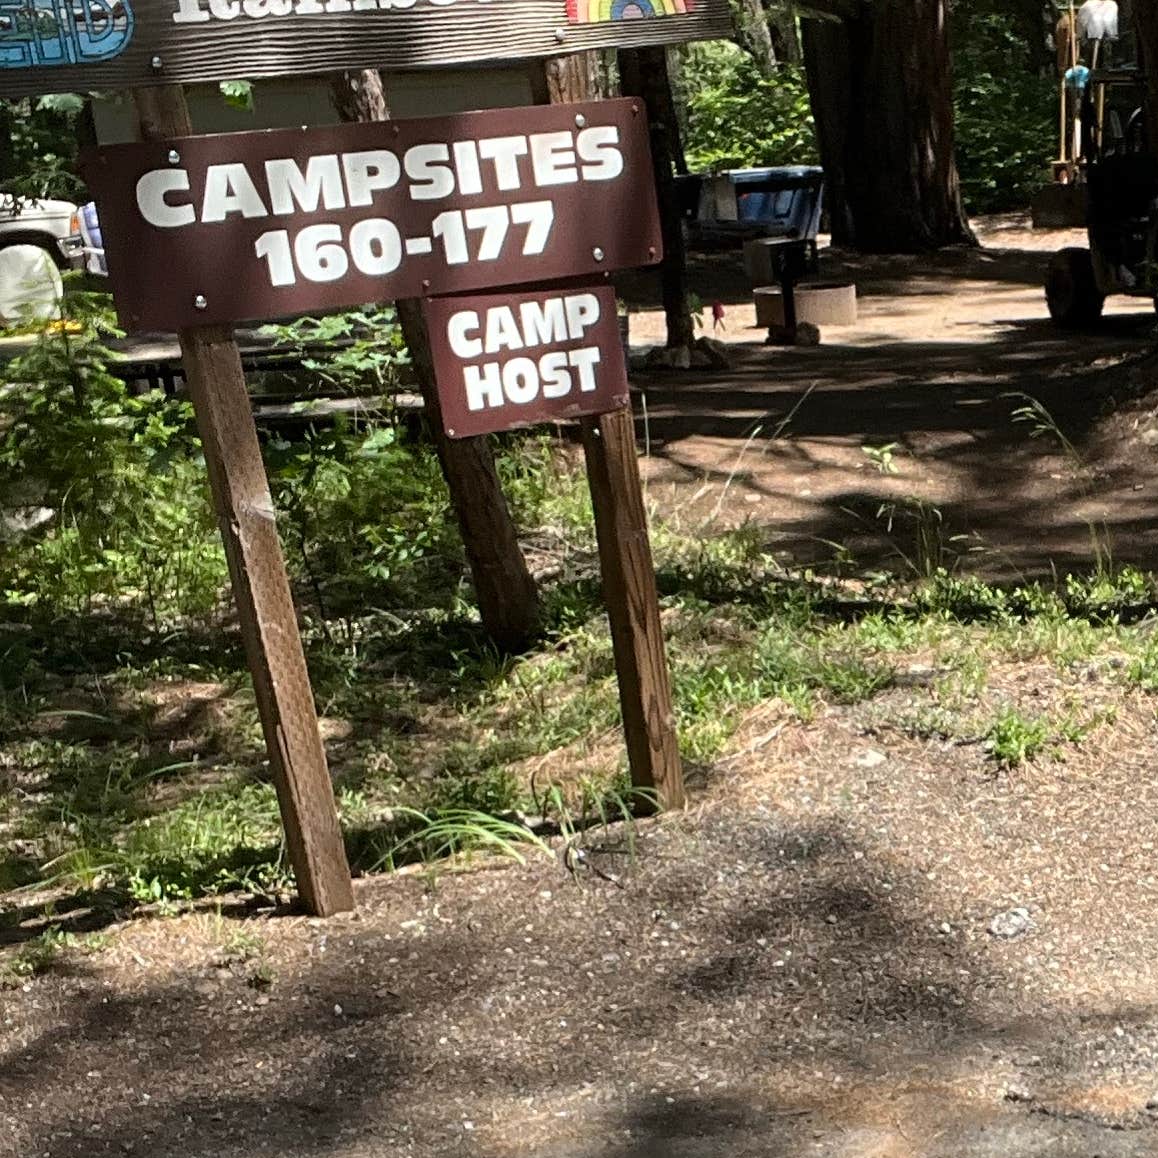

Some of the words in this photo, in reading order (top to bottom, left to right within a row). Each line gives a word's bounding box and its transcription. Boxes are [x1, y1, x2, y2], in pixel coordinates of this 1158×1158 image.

[135, 126, 624, 228] CAMPSITES
[254, 200, 555, 288] 160-177
[446, 294, 600, 359] CAMP
[463, 347, 601, 412] HOST
